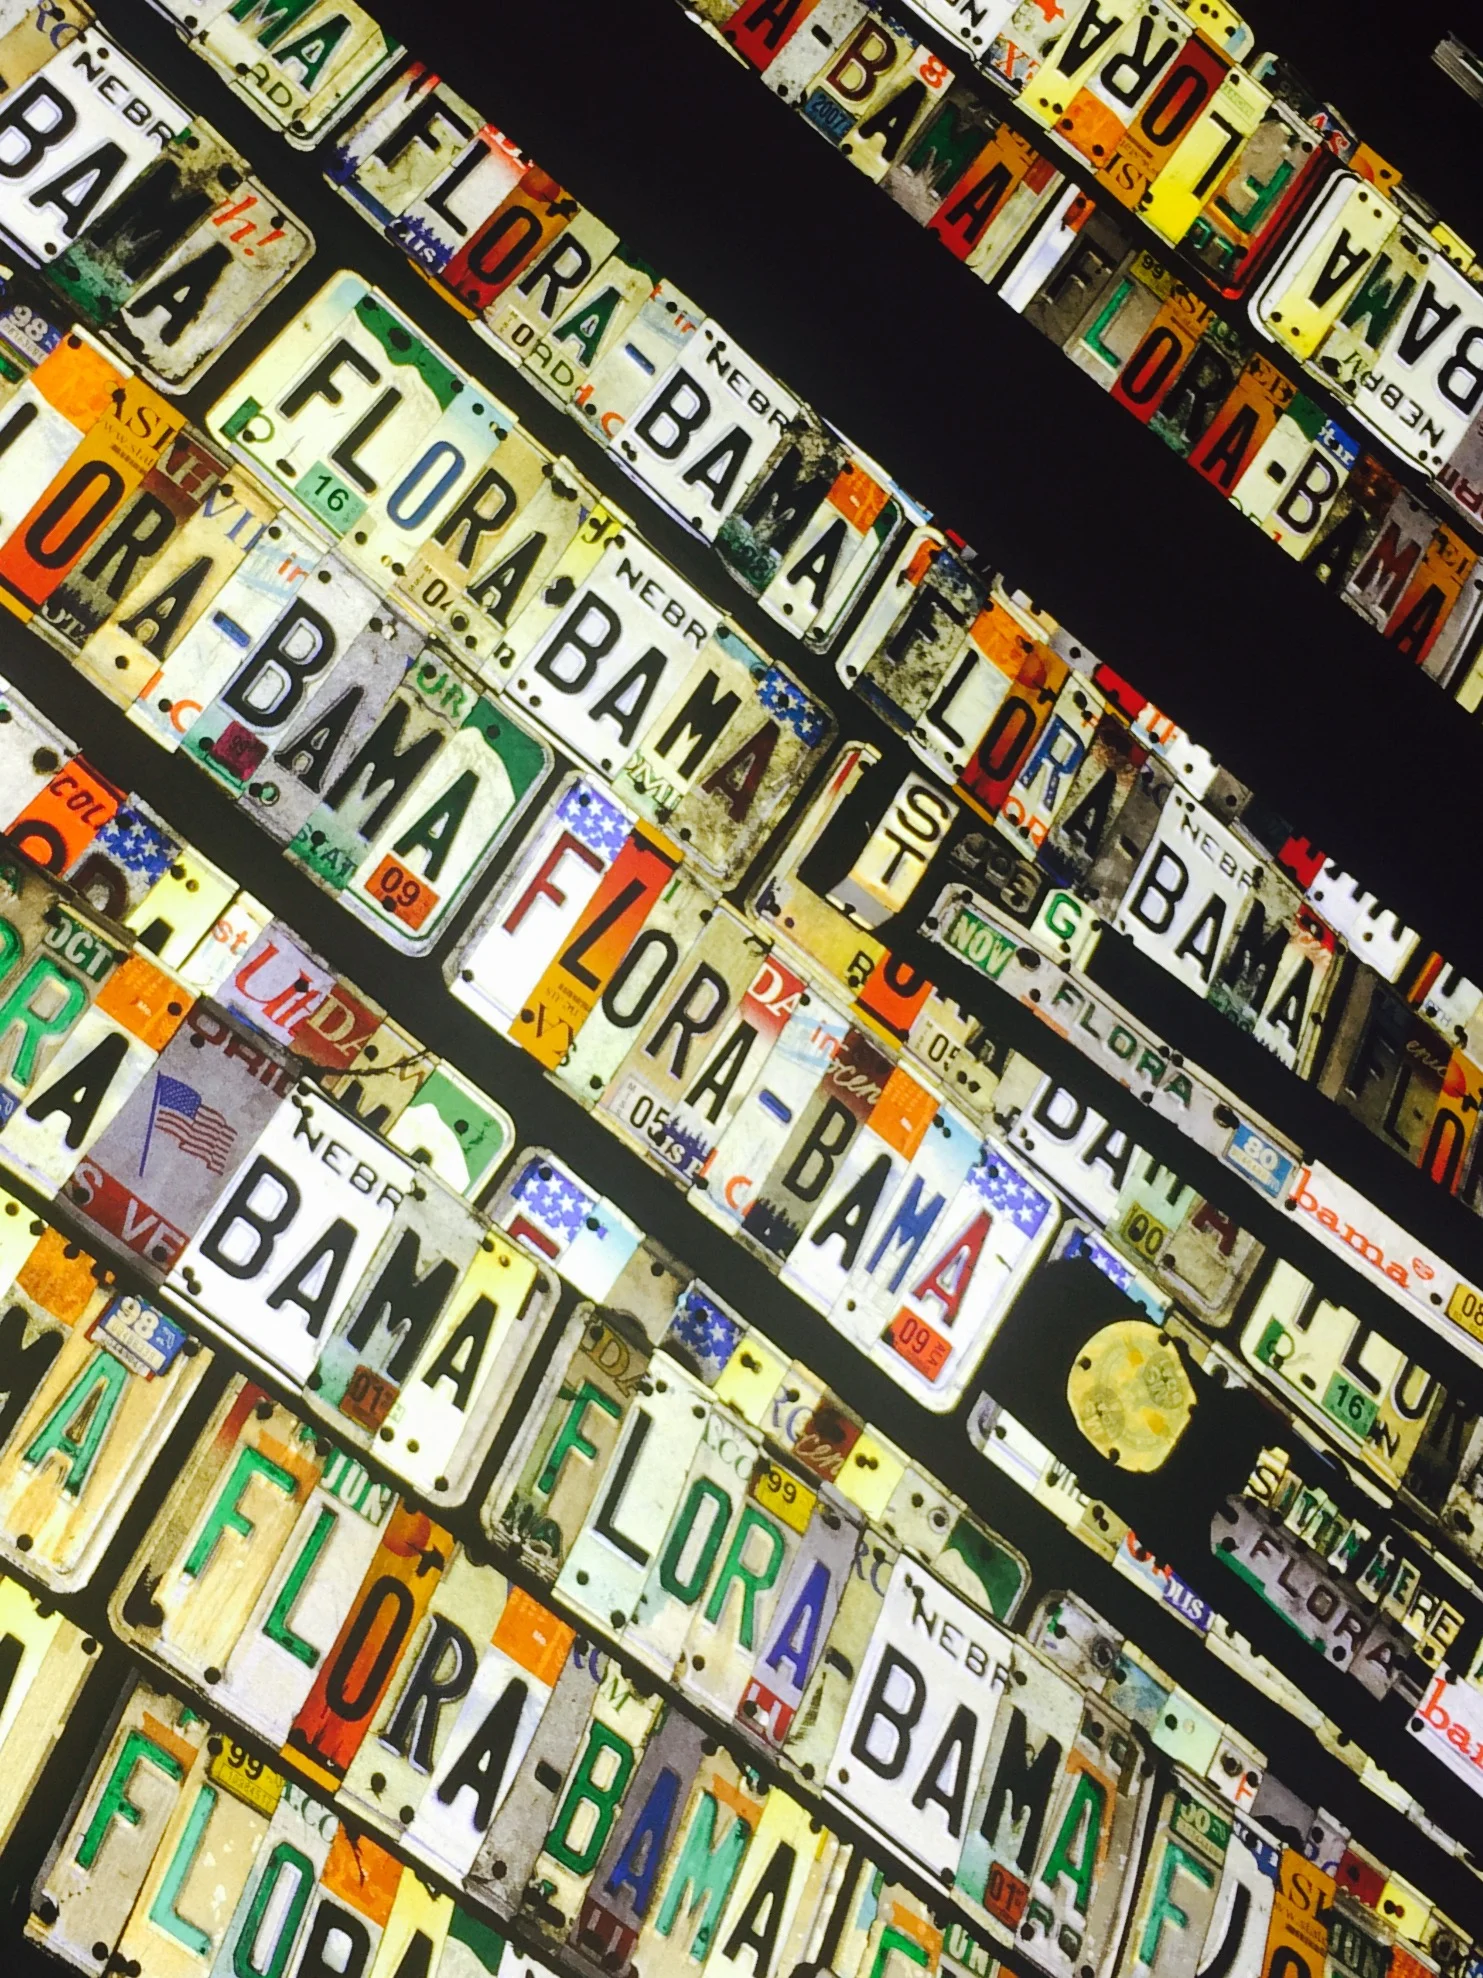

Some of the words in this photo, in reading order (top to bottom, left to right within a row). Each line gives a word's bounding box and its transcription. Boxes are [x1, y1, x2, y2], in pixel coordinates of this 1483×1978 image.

[811, 96, 849, 133] 2007
[315, 475, 349, 512] 16
[280, 338, 781, 822] FLORA-BAMA
[616, 557, 708, 650] NEBR
[380, 865, 422, 908] 09
[949, 919, 1020, 982] NOV
[1052, 981, 1195, 1112] FLORA
[503, 831, 994, 1327] FLORA-BAMA
[1243, 1135, 1280, 1171] 80
[1289, 1168, 1411, 1291] bama
[116, 1296, 160, 1341] 98
[899, 1317, 930, 1354] 09
[1335, 1382, 1366, 1421] 16
[767, 1470, 798, 1500] 99
[1250, 1532, 1397, 1681] FLORA
[534, 1381, 1105, 1916] FLORA-BAMA
[227, 1743, 264, 1778] 99
